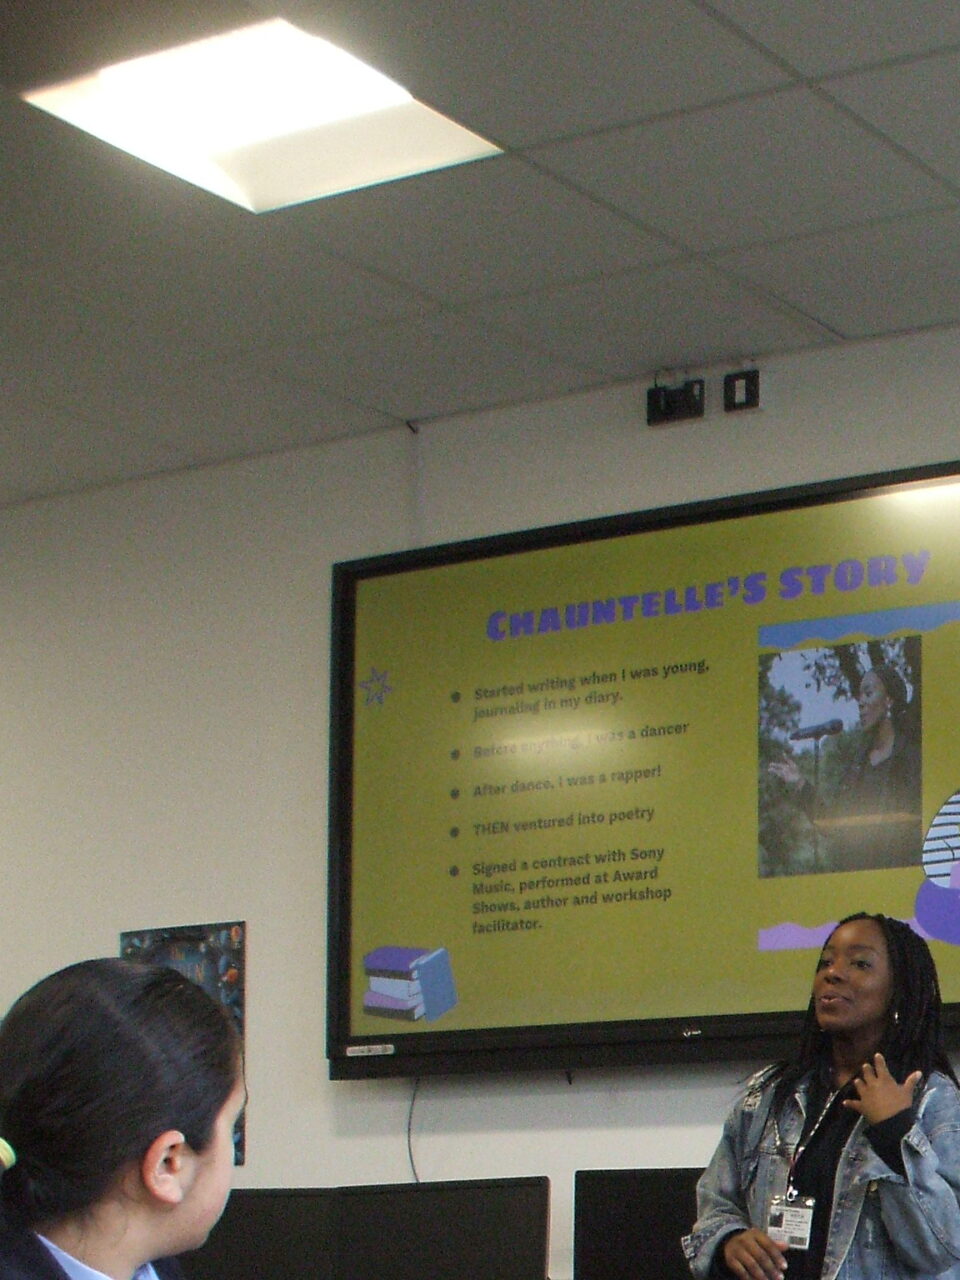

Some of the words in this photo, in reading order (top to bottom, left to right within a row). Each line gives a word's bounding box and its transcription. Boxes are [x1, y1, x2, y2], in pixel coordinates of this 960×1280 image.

[779, 550, 931, 600] STORY
[474, 683, 524, 700] Started
[527, 676, 576, 693] writing
[580, 672, 617, 686] when
[621, 667, 626, 681] I
[630, 667, 659, 681] was
[472, 701, 540, 722] journaling
[543, 698, 556, 711] in
[560, 696, 580, 710] my
[596, 730, 624, 744] was
[627, 728, 636, 739] a
[640, 722, 690, 739] dancer
[473, 782, 506, 798] After
[567, 773, 595, 786] was
[598, 771, 607, 783] a
[610, 763, 662, 784] rapper!
[473, 821, 510, 836] THEN
[514, 814, 574, 832] ventured
[578, 811, 606, 826] into
[609, 806, 655, 825] poetry
[472, 859, 517, 878] Signed
[520, 859, 529, 871] a
[532, 853, 591, 869] contract
[595, 848, 627, 864] with
[630, 847, 665, 862] Sony
[472, 882, 516, 896] Music,
[518, 872, 591, 894] performed
[594, 871, 609, 884] at
[612, 865, 659, 882] Award
[472, 900, 521, 915] Shows,
[523, 895, 569, 911] author
[572, 890, 599, 906] and
[601, 885, 672, 904] workshop
[472, 918, 544, 935] facilitator.
